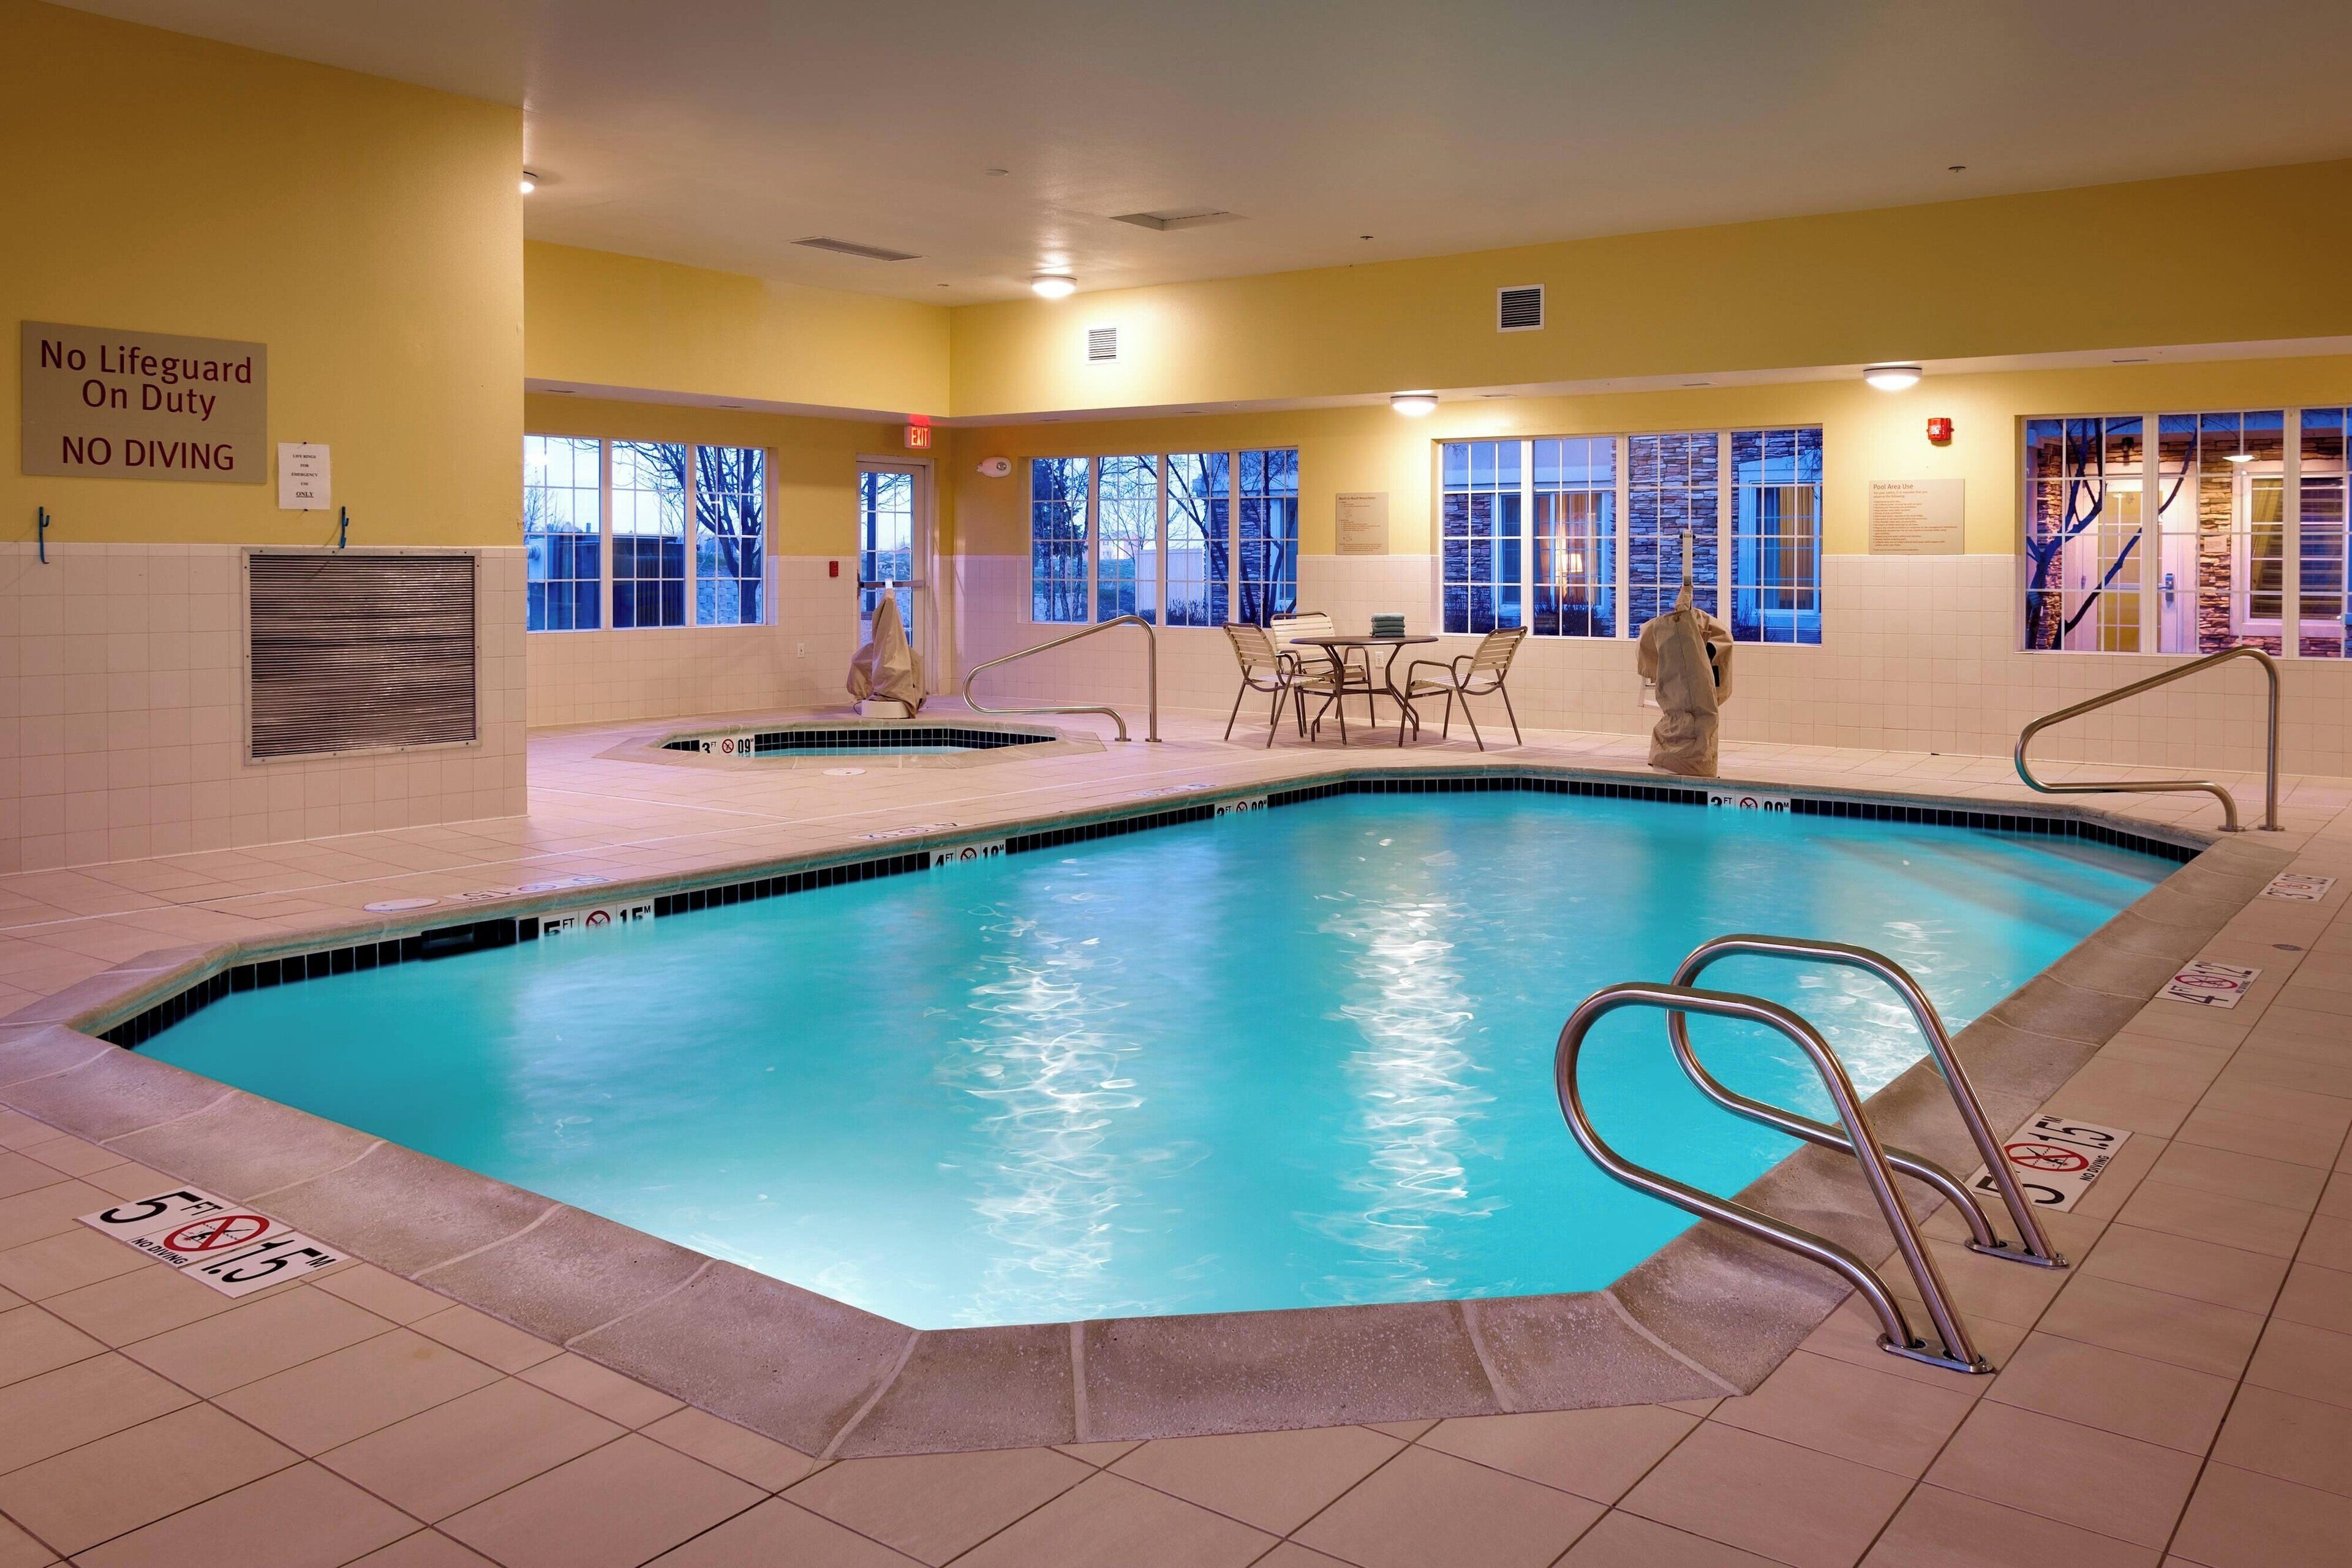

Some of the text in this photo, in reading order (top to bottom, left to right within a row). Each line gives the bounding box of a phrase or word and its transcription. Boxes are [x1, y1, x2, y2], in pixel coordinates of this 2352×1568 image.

[41, 339, 251, 385] No Lifeguard
[82, 379, 216, 422] On Duty
[62, 435, 233, 470] NO DIVING
[911, 427, 929, 447] EXIT
[2079, 1155, 2109, 1182] NO DIVING
[131, 1238, 188, 1264] NO DIVING
